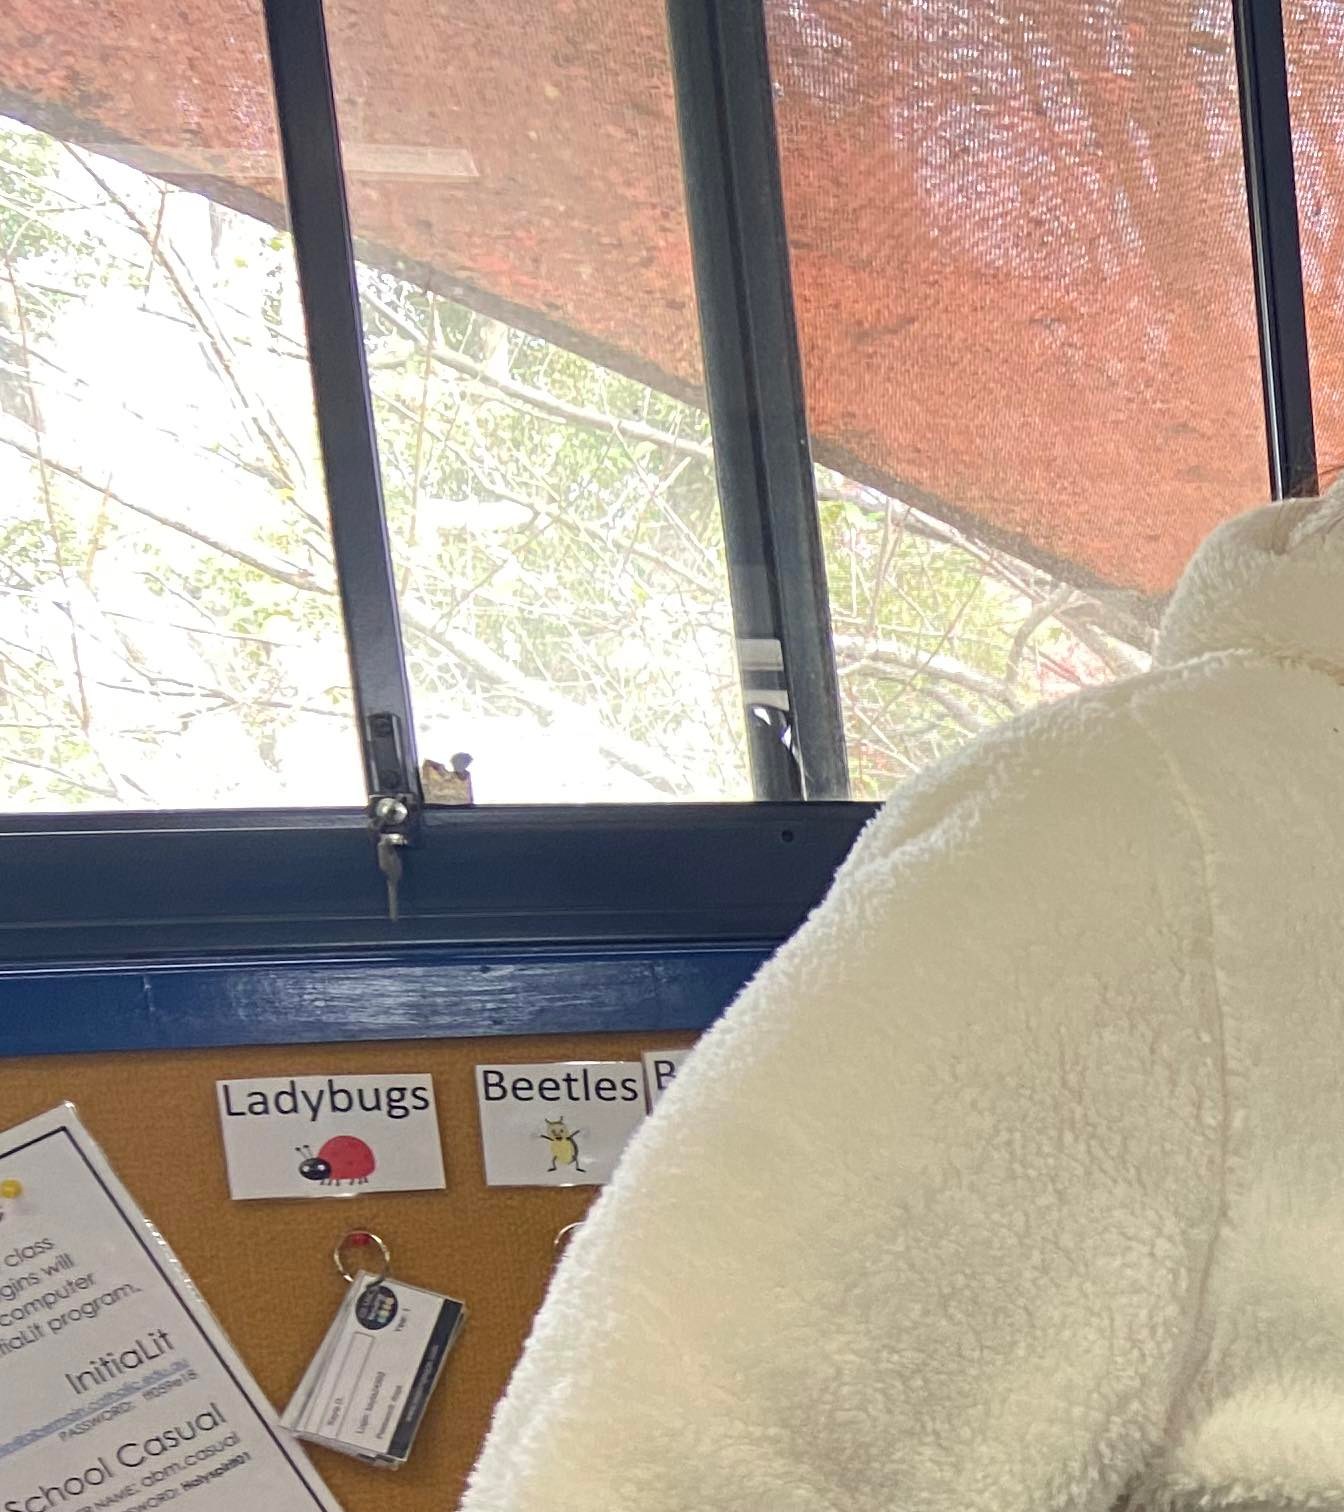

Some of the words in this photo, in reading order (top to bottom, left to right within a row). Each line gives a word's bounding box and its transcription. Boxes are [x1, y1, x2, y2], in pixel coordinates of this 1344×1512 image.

[222, 1079, 430, 1120] Ladybugs
[482, 1067, 638, 1103] Beetles
[4, 1237, 55, 1268] class
[41, 1252, 75, 1277] will
[0, 1272, 96, 1327] computer
[65, 1328, 174, 1395] InitiaLit
[116, 1402, 227, 1467] Casual
